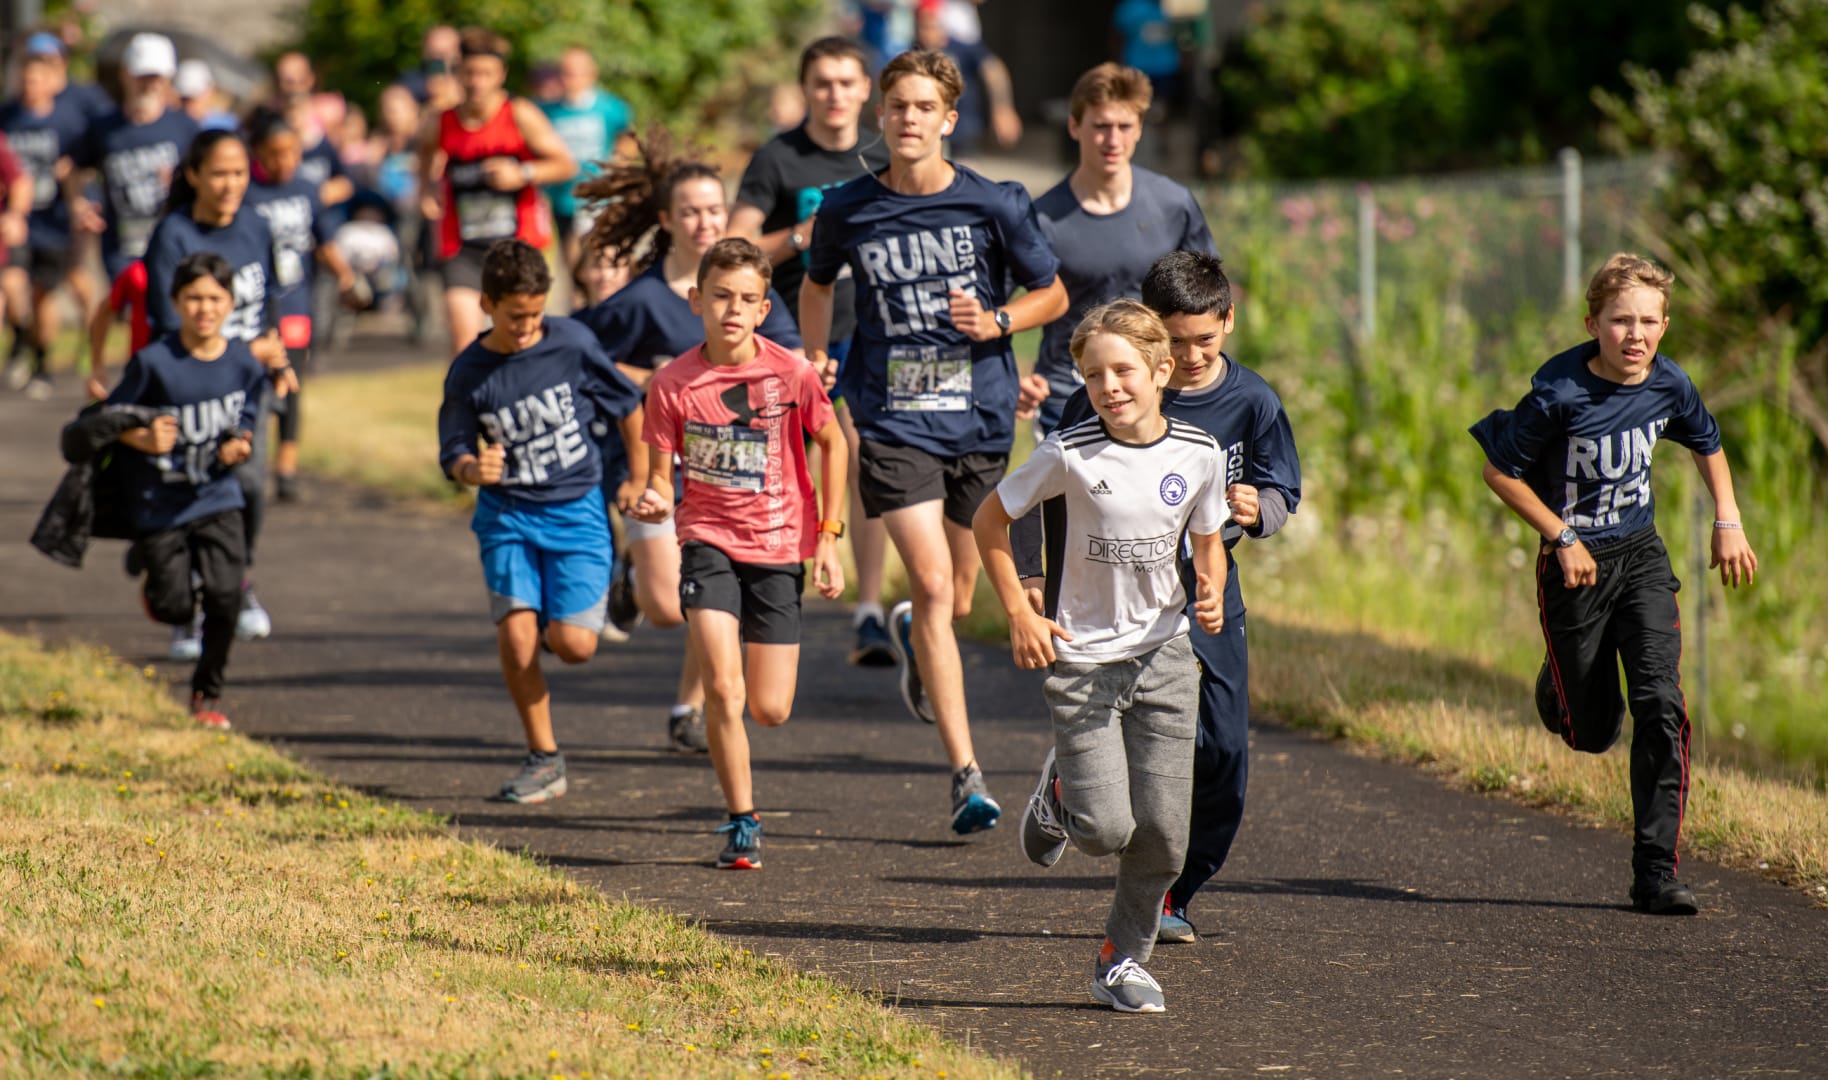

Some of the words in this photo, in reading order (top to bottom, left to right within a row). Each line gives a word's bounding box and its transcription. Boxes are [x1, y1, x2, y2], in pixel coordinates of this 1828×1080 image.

[857, 227, 960, 286] RUN
[953, 225, 976, 271] FOR
[163, 398, 231, 445] UN
[1227, 440, 1244, 487] FOR
[1566, 420, 1658, 480] RUN
